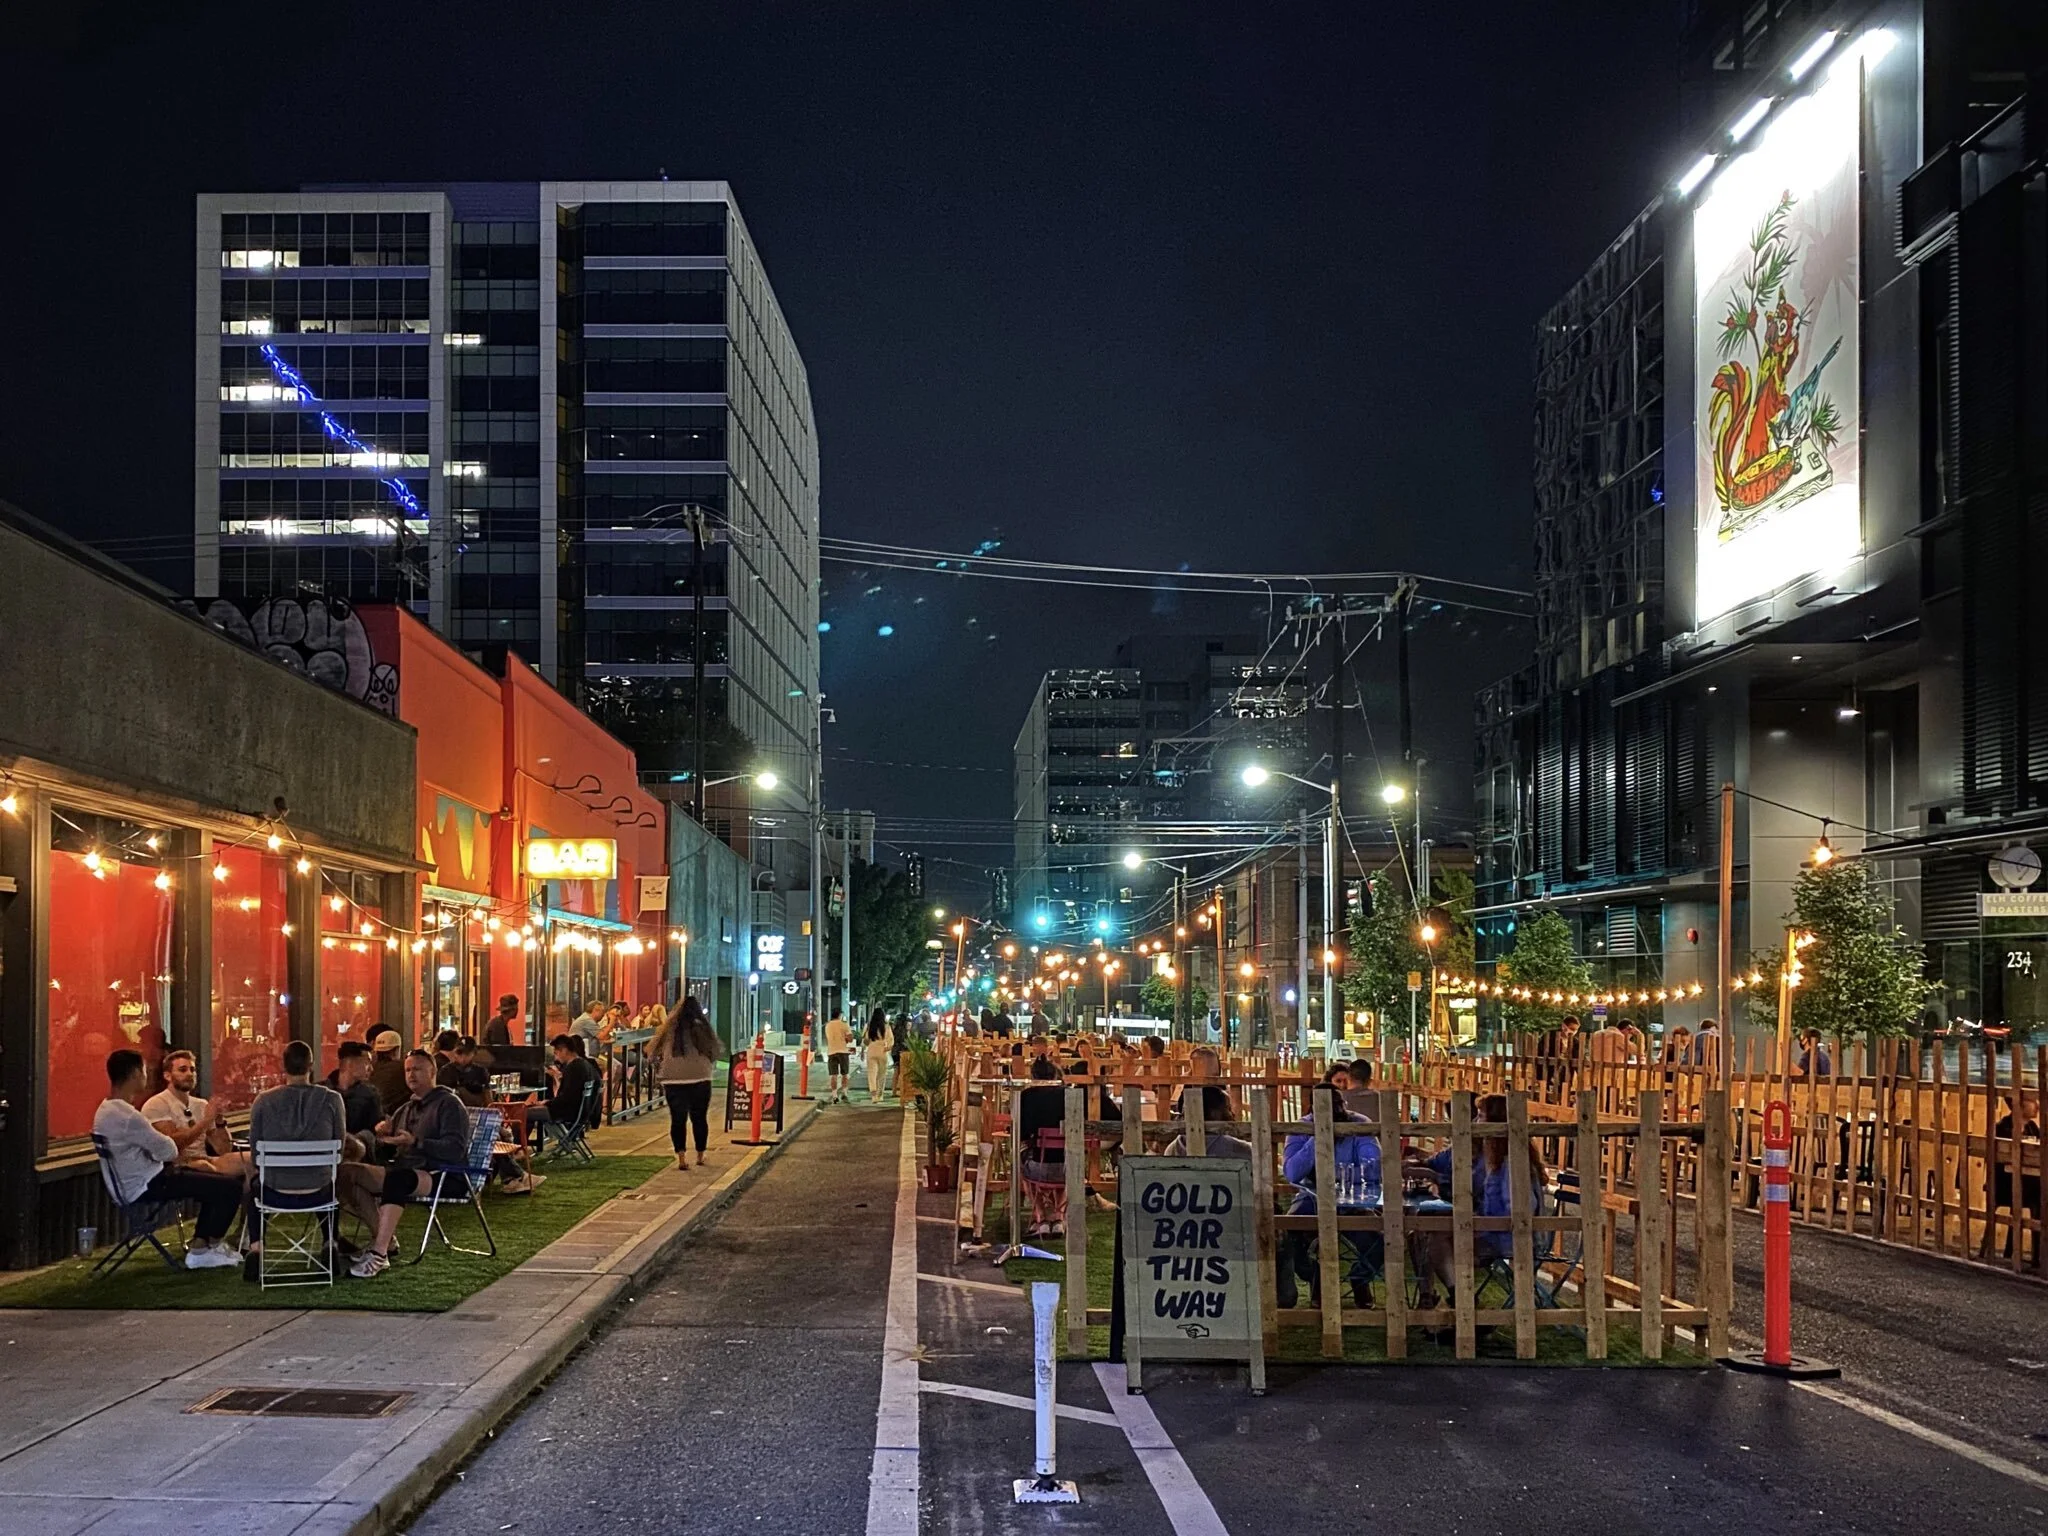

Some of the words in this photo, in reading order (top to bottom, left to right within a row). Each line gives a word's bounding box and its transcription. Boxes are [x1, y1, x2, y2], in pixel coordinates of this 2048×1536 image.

[528, 841, 609, 873] BAR
[1990, 906, 2046, 914] ROASTERS
[1141, 1182, 1233, 1215] GOLD
[1152, 1217, 1223, 1249] BAR
[1146, 1254, 1230, 1285] THIS
[1154, 1287, 1226, 1320] WAY
